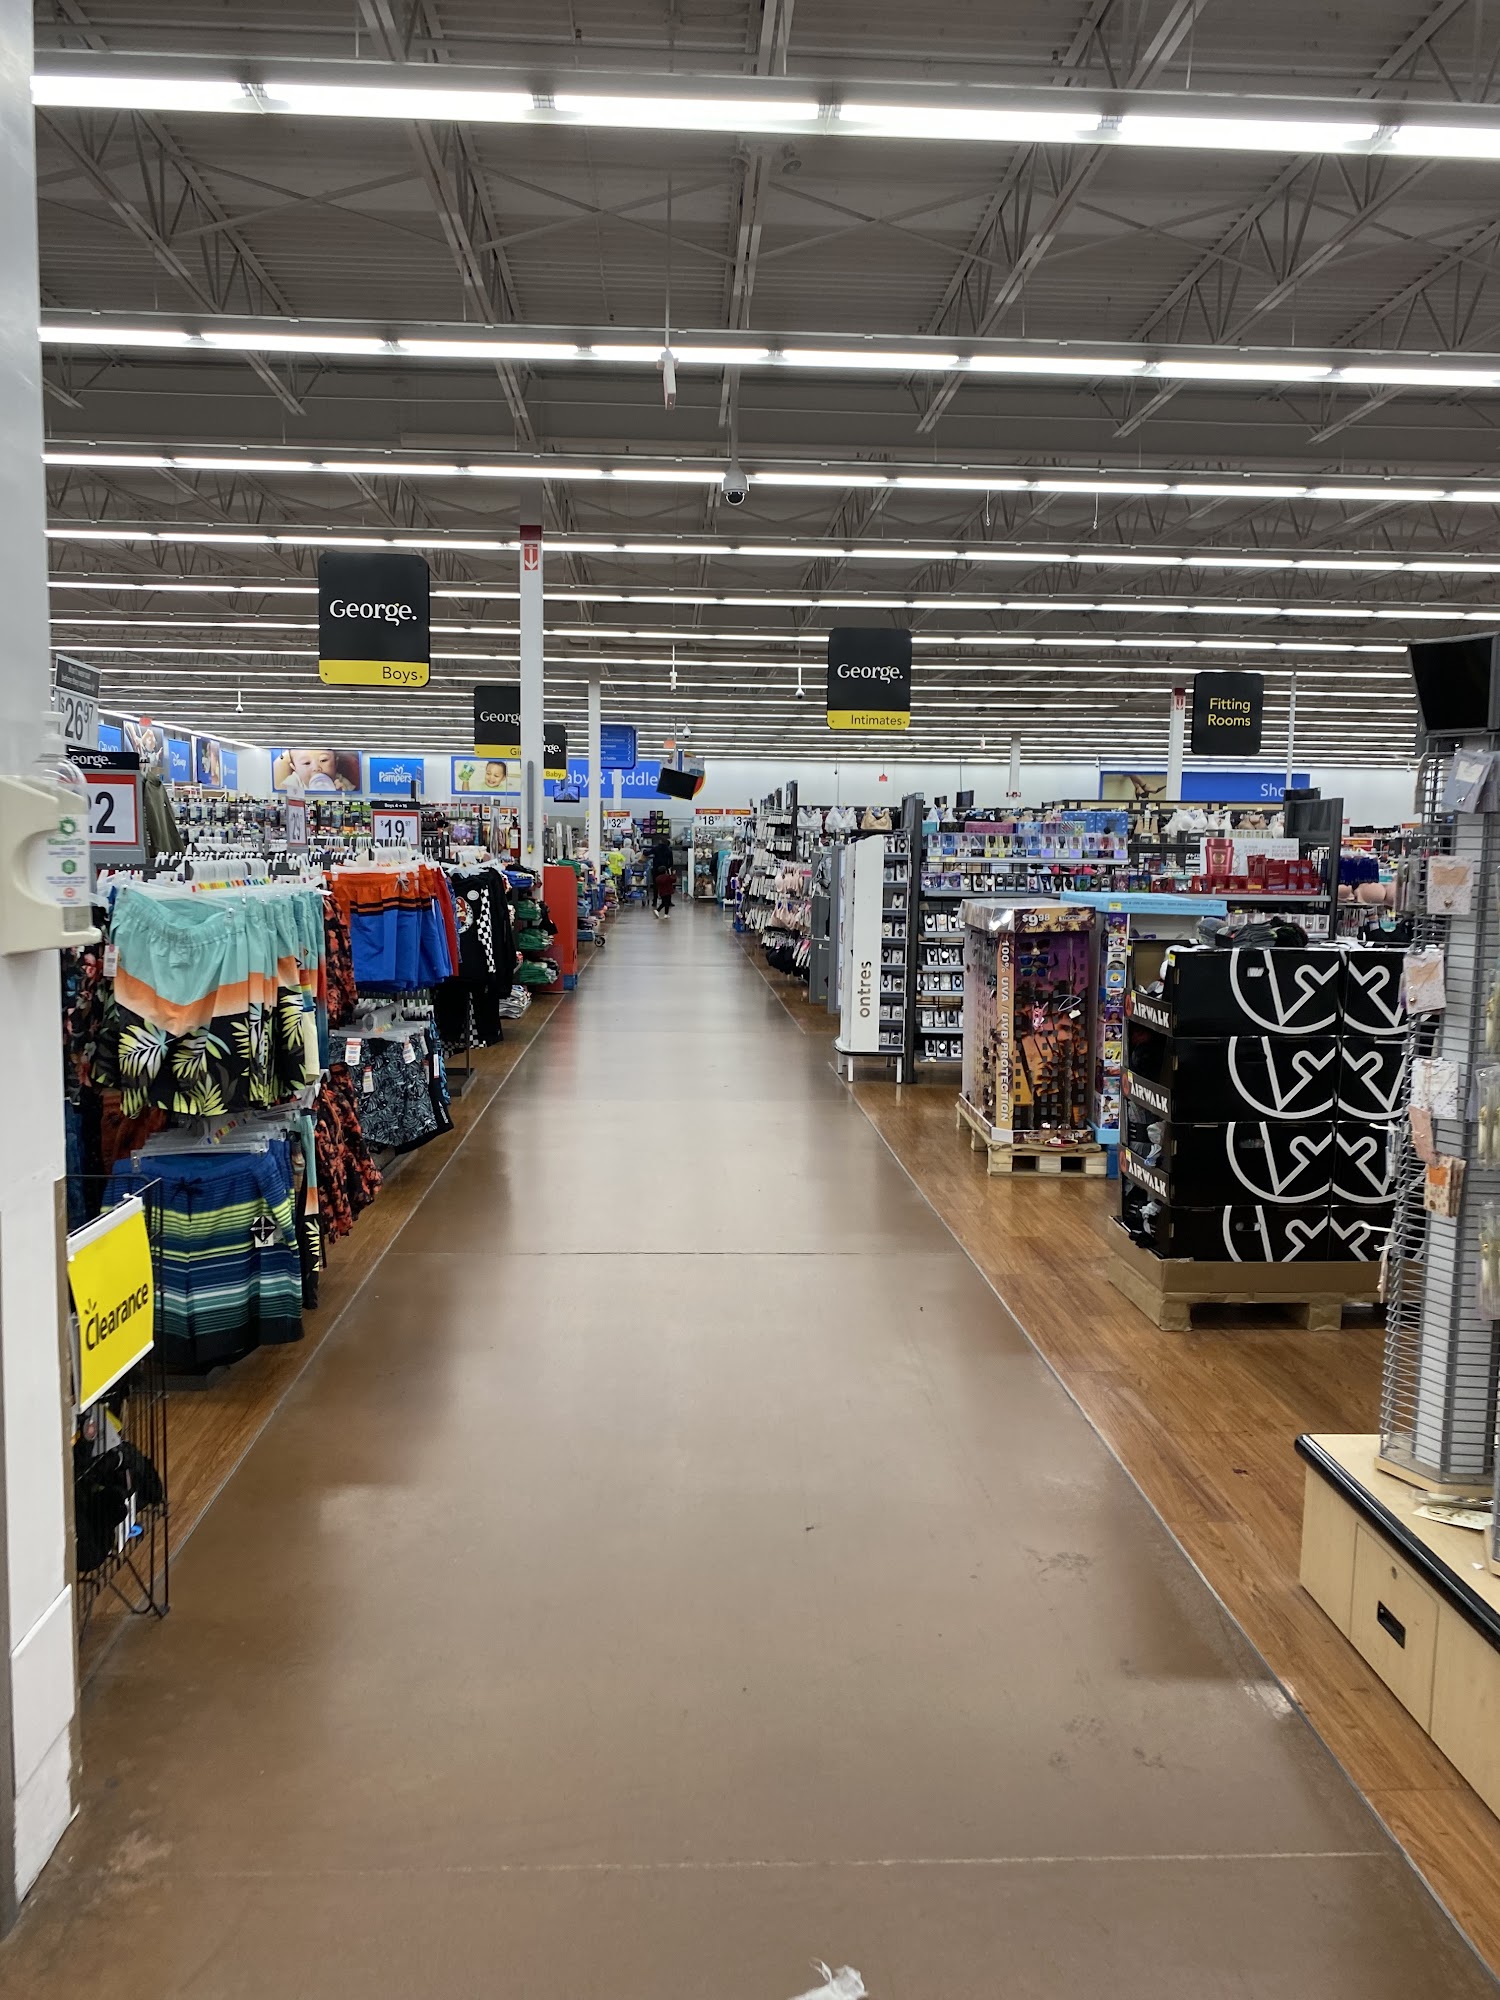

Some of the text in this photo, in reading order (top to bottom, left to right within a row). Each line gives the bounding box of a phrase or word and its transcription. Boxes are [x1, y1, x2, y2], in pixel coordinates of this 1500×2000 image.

[329, 599, 418, 626] George.
[382, 666, 418, 684] Boys
[837, 663, 903, 684] George.
[1209, 697, 1251, 714] Fitting
[851, 714, 902, 726] Intimates
[1207, 714, 1251, 727] Rooms
[72, 754, 112, 769] eorge.
[379, 772, 413, 786] Pampers
[545, 770, 561, 779] Baby
[556, 769, 590, 788] aby
[1000, 940, 1010, 973] 100%
[1000, 976, 1010, 1002] UVA
[1000, 1013, 1010, 1037] UVB
[1132, 1001, 1170, 1029] AIRWALK
[1000, 1041, 1010, 1122] PROTECTION
[1130, 1080, 1169, 1114] AIRWALK
[1128, 1161, 1167, 1198] AIRWALK
[85, 1282, 149, 1351] Clearance
